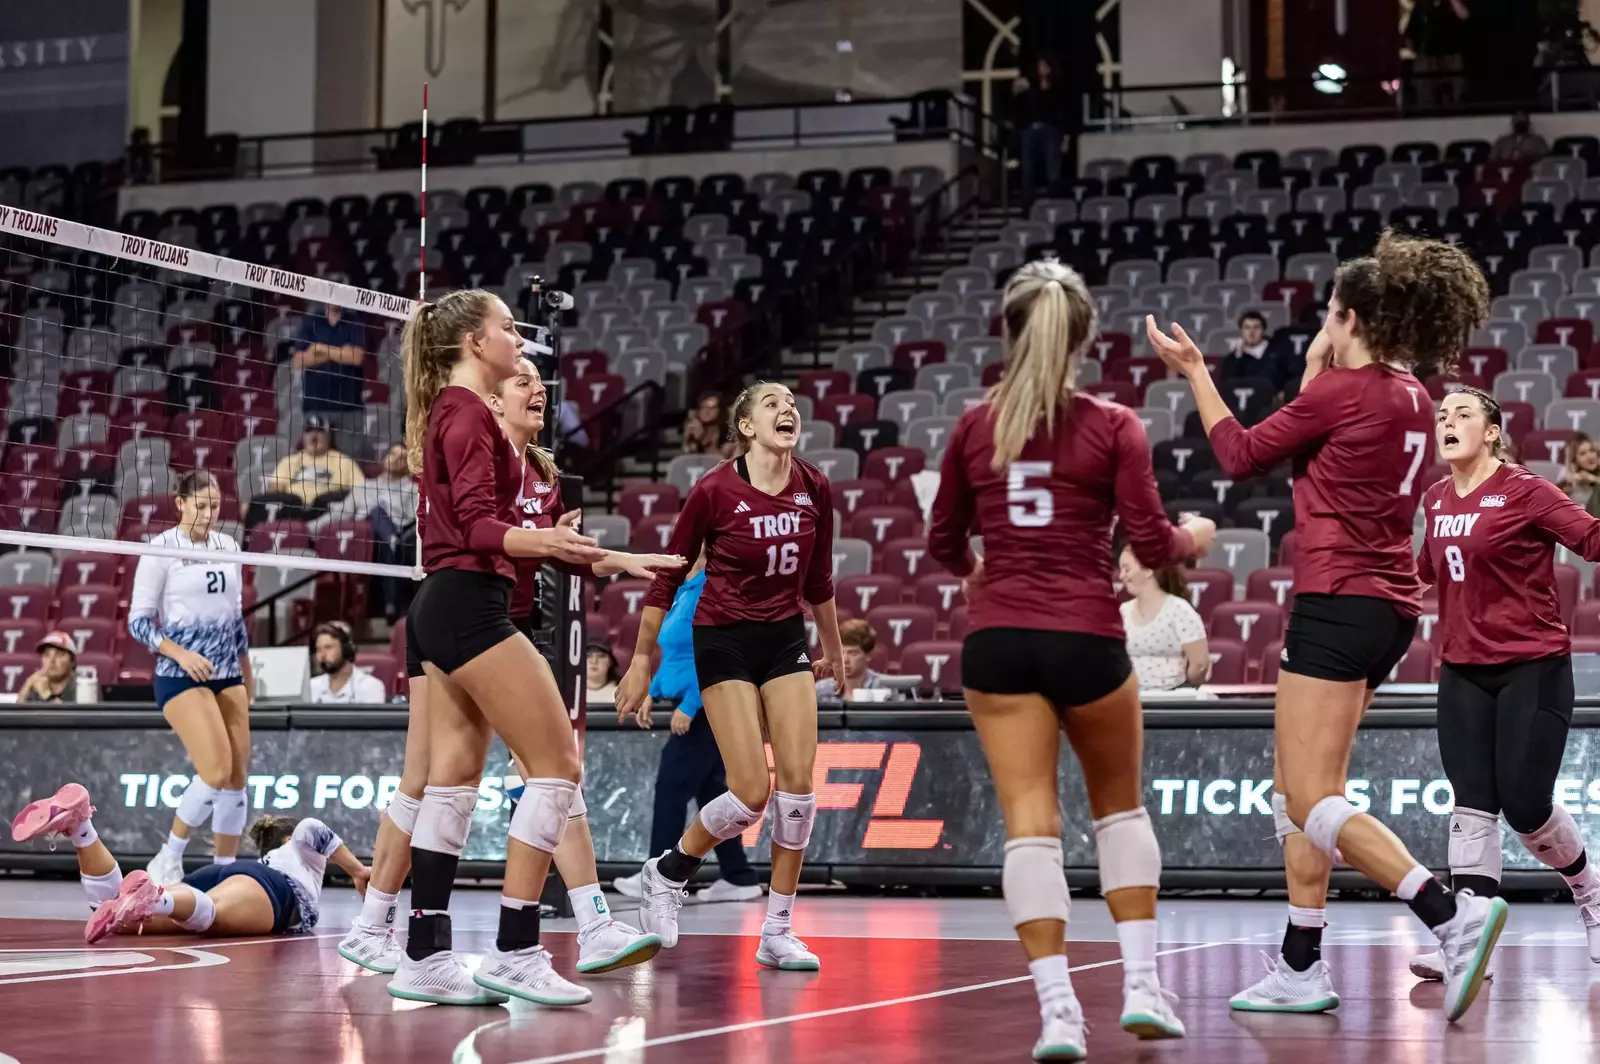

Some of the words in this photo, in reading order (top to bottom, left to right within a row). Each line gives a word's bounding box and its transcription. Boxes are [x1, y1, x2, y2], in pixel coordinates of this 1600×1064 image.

[0, 35, 99, 69] SITY
[12, 209, 59, 237] TROJANS
[120, 235, 146, 255] TROY
[148, 242, 190, 266] TROJANS
[244, 263, 268, 283] TROY
[269, 270, 306, 292] TROJANS
[355, 288, 377, 308] TROY
[378, 293, 411, 315] TROJANS
[1400, 431, 1427, 496] 7
[1007, 461, 1054, 527] 5
[1479, 495, 1507, 507] SBC
[749, 511, 803, 539] TROY
[1433, 512, 1481, 538] TROY
[764, 542, 799, 577] 16
[1445, 545, 1465, 582] 8
[206, 568, 226, 594] 21
[119, 773, 301, 810] TICTS
[1152, 779, 1371, 815] TICKS
[1390, 778, 1456, 815] FO
